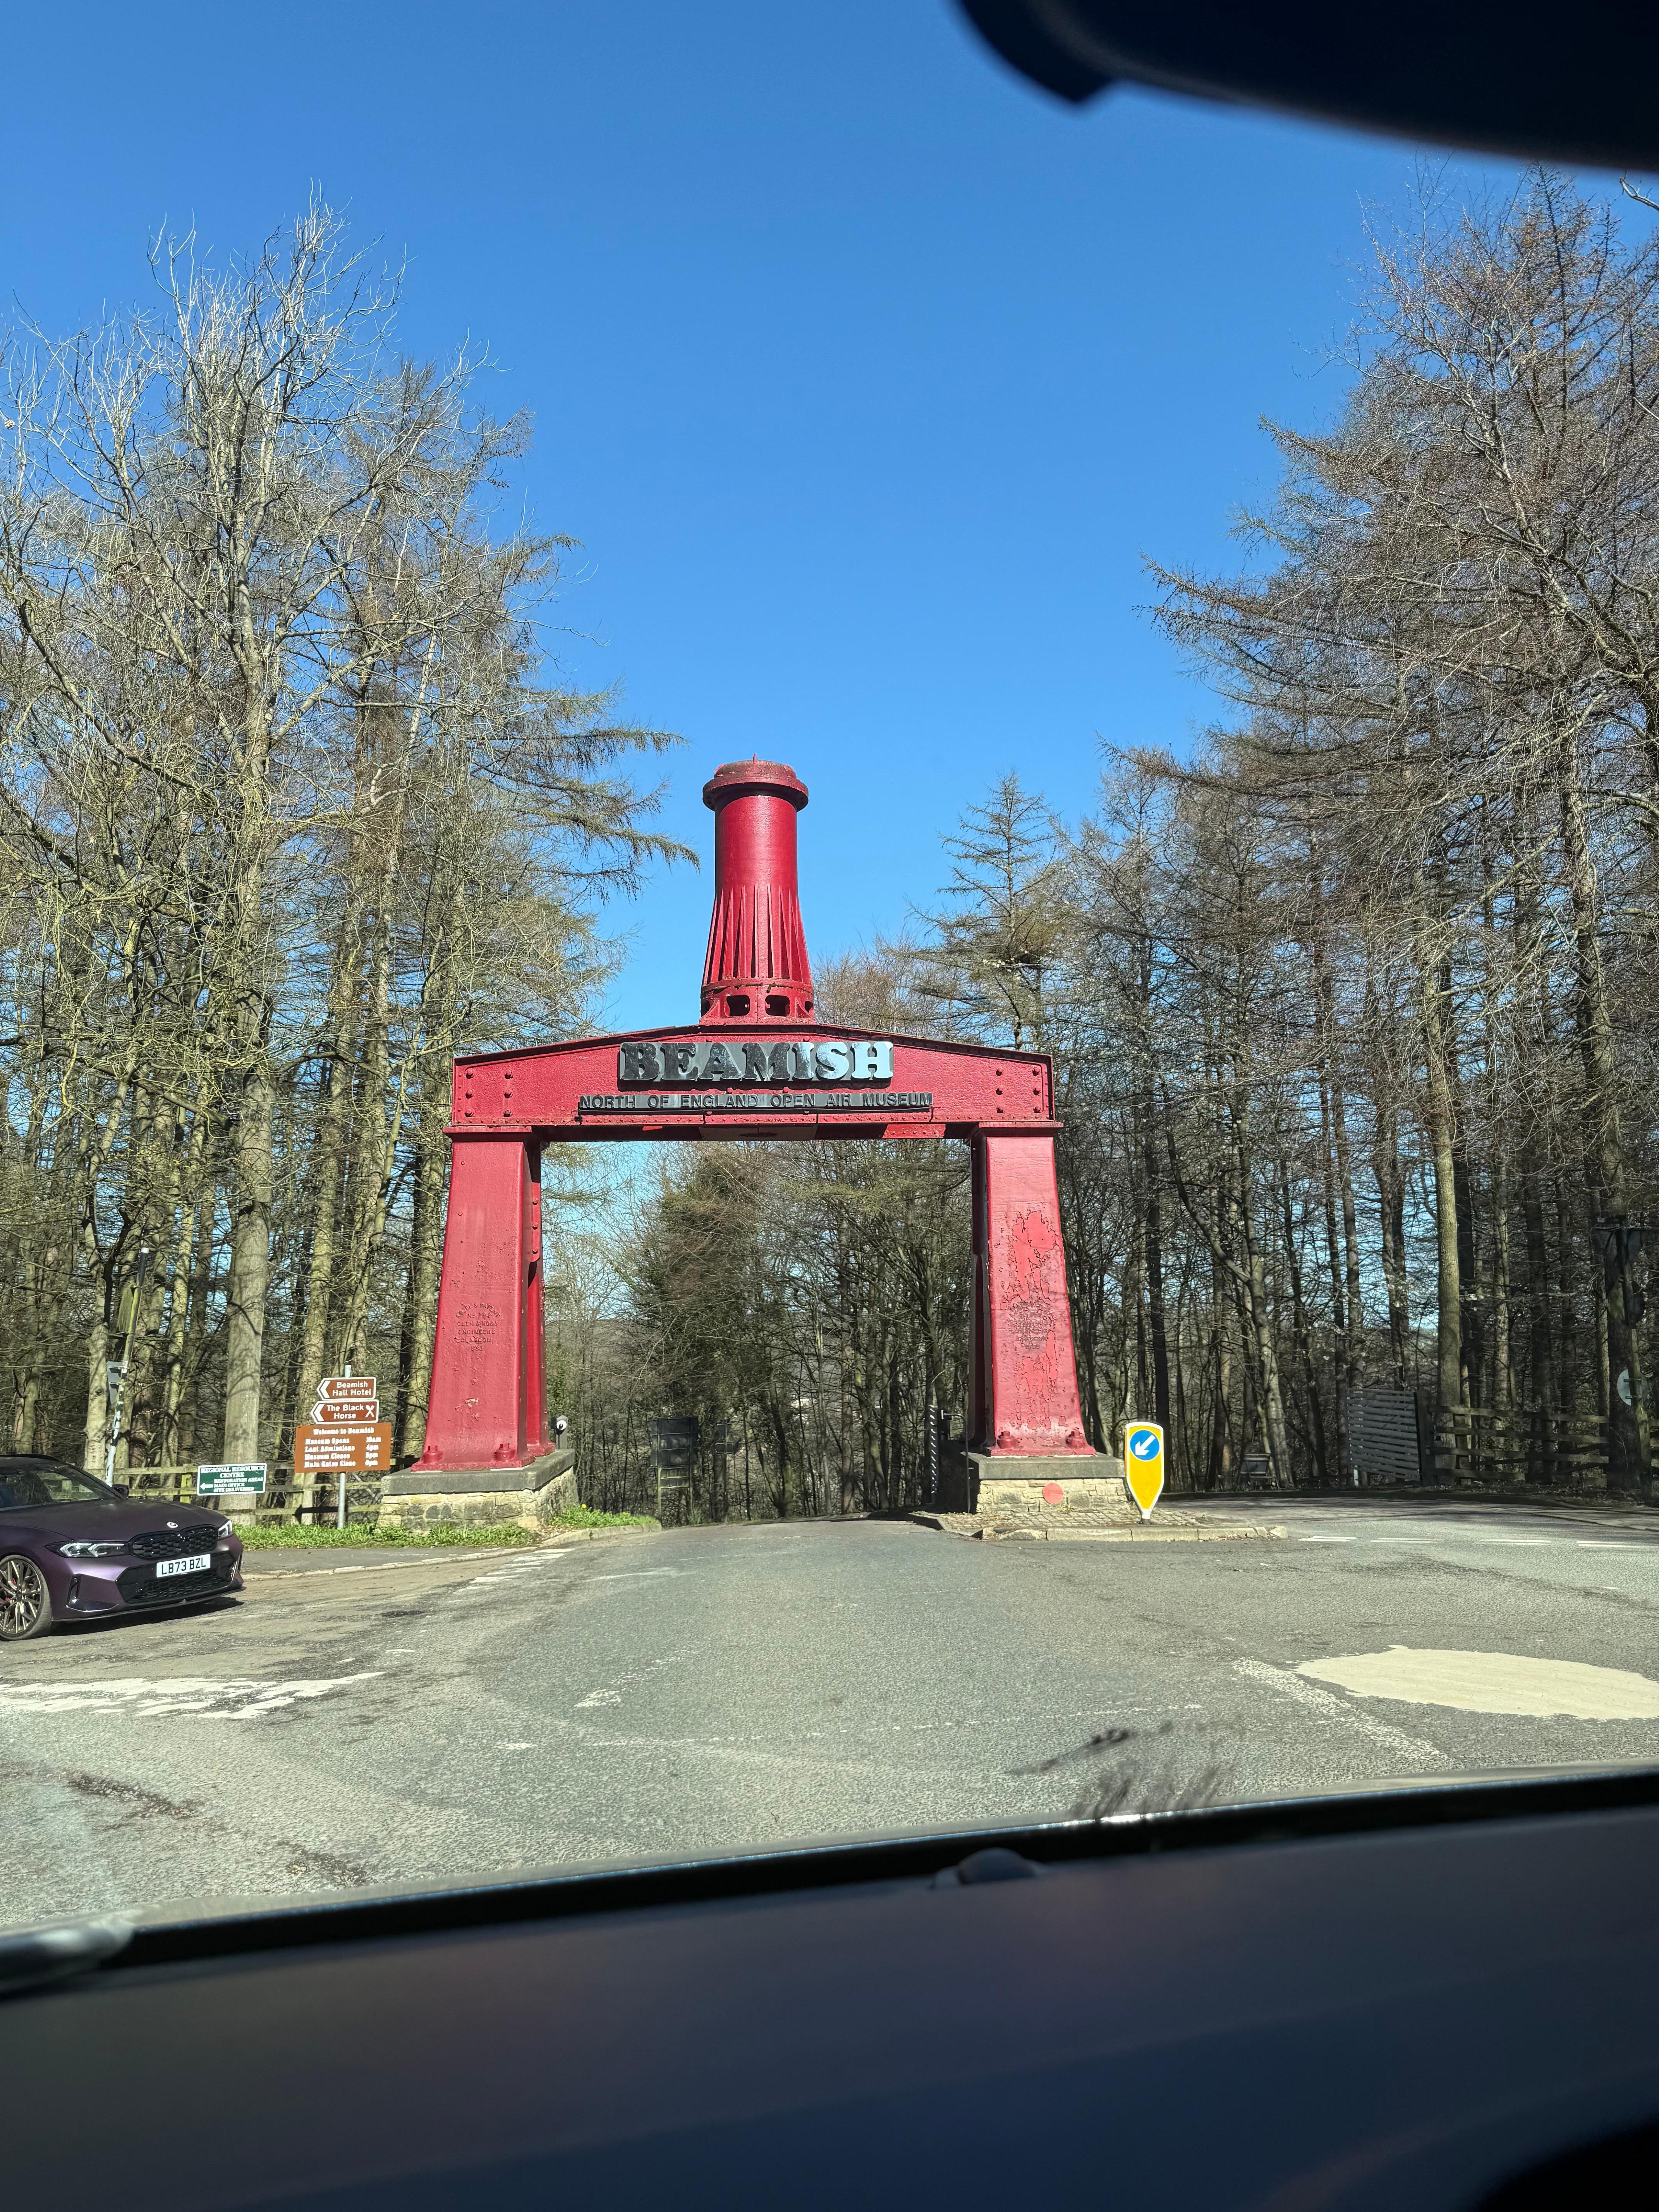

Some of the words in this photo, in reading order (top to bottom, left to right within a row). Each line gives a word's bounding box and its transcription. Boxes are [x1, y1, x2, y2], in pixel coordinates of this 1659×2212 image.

[621, 1041, 893, 1080] BEAMISH
[580, 1095, 635, 1108] NORTH
[647, 1095, 670, 1108] OF
[680, 1095, 758, 1108] ENGLAND
[770, 1094, 815, 1107] OPEN
[826, 1094, 852, 1106] AIR
[862, 1092, 933, 1106] MUSEUM
[161, 1561, 186, 1575] LB73
[189, 1558, 206, 1570] BZL
